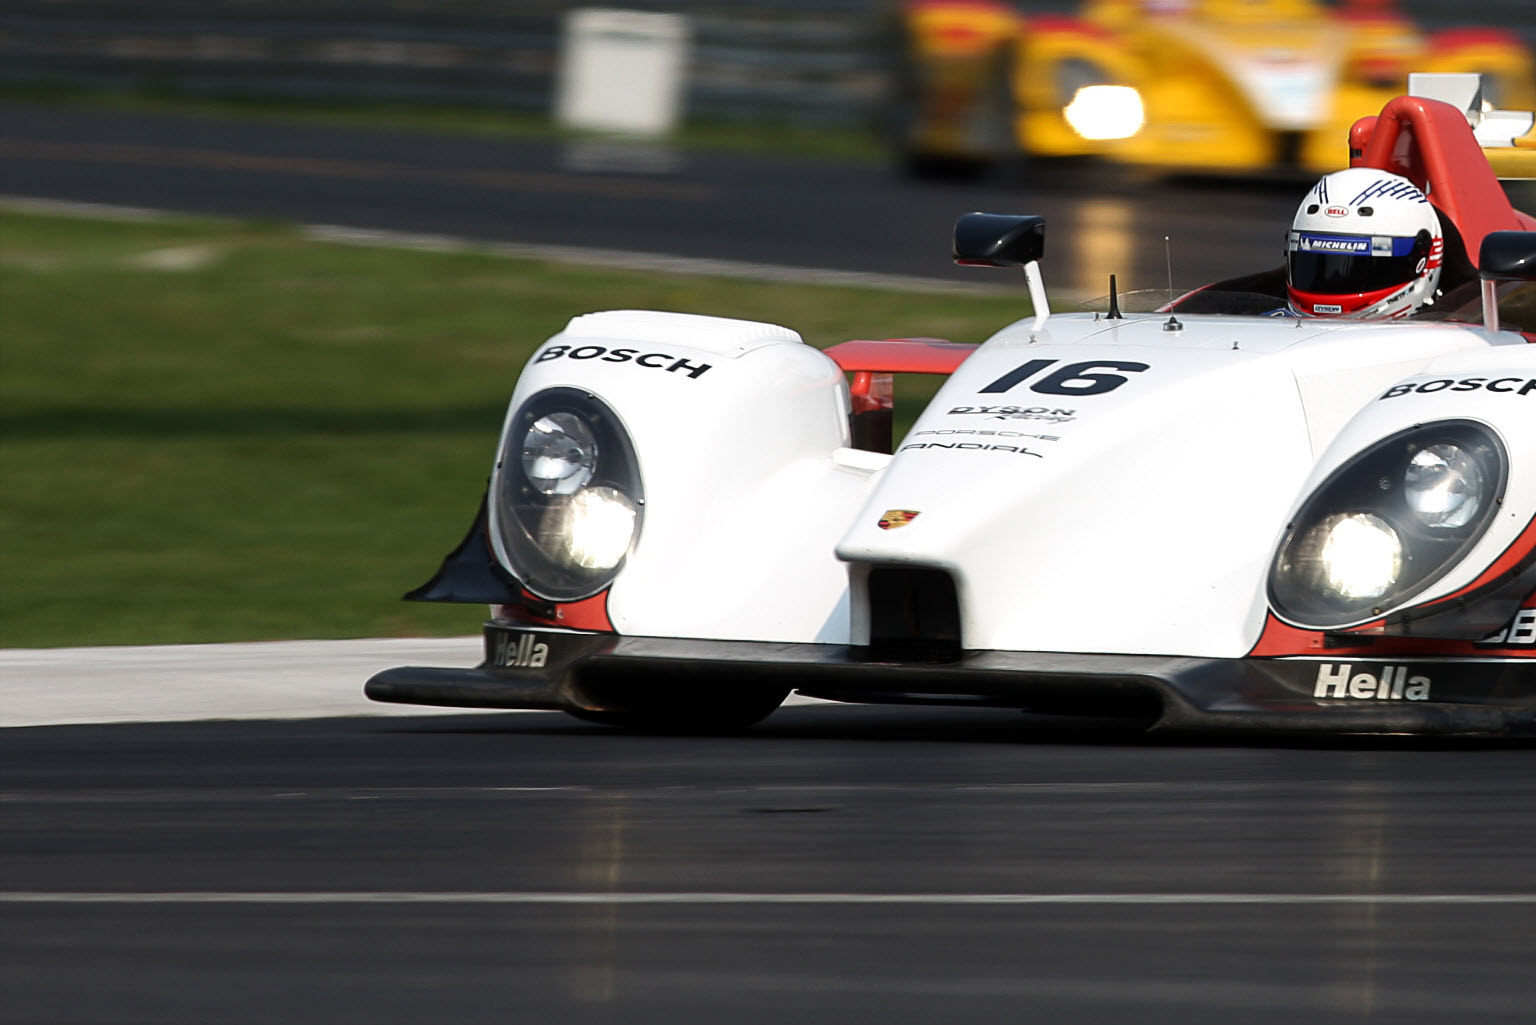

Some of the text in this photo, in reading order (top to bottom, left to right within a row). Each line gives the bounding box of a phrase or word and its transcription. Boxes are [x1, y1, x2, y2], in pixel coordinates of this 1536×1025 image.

[1312, 240, 1367, 251] MICHELIN
[535, 345, 712, 379] BOSCH
[977, 359, 1151, 396] 16
[946, 406, 1077, 416] DYSON
[914, 429, 1061, 442] PORSCHE
[900, 442, 1044, 458] ANDIAL
[495, 632, 549, 667] Hella
[1313, 663, 1432, 700] Hella
